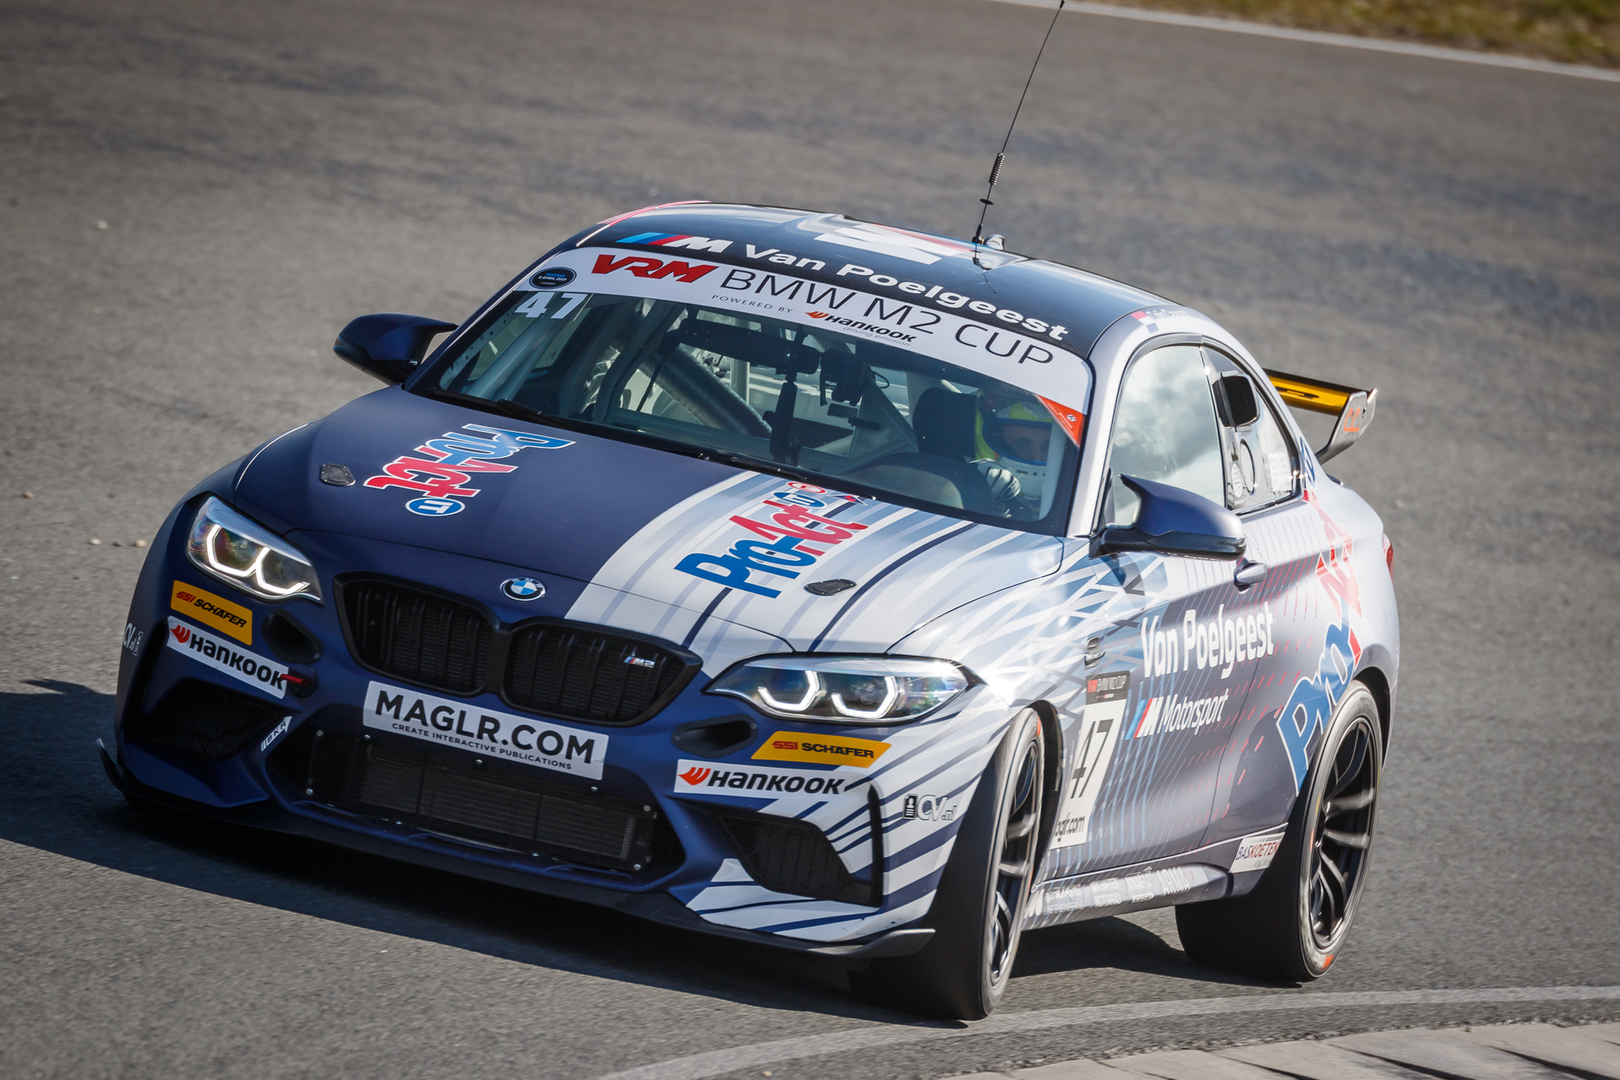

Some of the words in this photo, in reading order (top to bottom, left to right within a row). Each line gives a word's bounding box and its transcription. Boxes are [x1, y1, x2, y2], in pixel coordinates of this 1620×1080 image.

[591, 254, 718, 283] VRM
[514, 291, 589, 320] 47
[712, 294, 773, 310] POWERED
[746, 244, 826, 271] Van
[836, 263, 1069, 342] Poelgeest
[720, 268, 857, 310] BMW
[863, 297, 942, 335] M2
[955, 323, 1054, 365] CUP
[843, 326, 872, 339] driving
[874, 332, 911, 347] emotion
[176, 591, 197, 603] SSI
[1141, 615, 1179, 678] Van
[1183, 601, 1274, 679] Poelgeest
[375, 690, 595, 764] MAGLR.COM
[1157, 688, 1229, 735] Motorsport
[392, 722, 429, 737] CREATE
[432, 732, 496, 753] INTERACTIVE
[500, 748, 572, 770] PUBLICATIONS
[772, 740, 799, 751] SSI
[1070, 718, 1114, 799] 47
[917, 794, 957, 821] CV.nl
